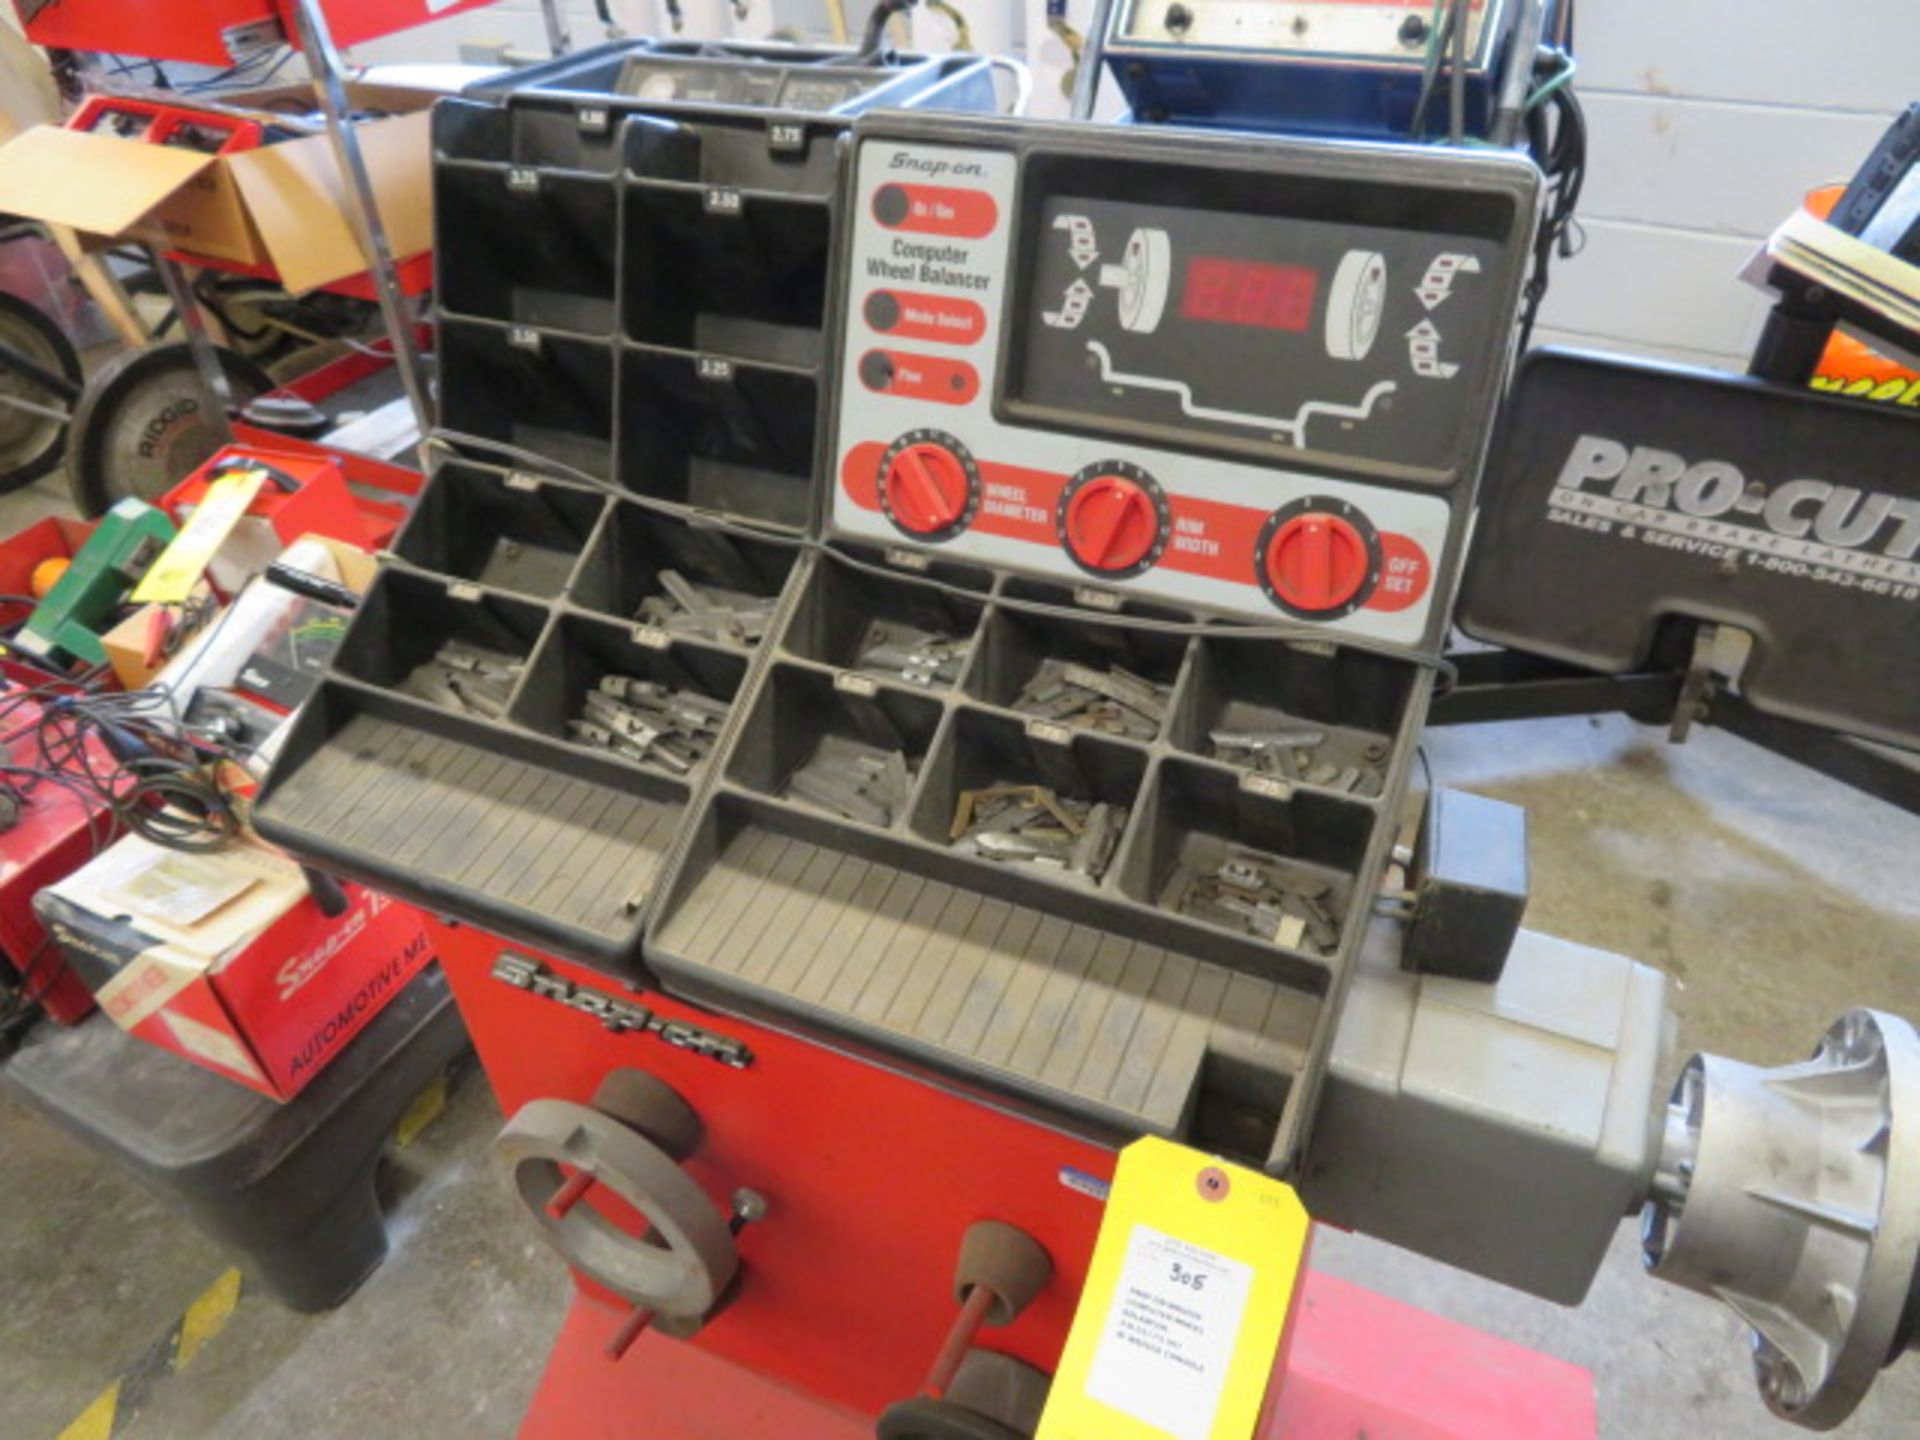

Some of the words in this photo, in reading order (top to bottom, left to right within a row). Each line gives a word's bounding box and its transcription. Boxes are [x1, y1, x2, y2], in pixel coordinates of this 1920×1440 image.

[773, 125, 801, 141] 2.75
[887, 152, 983, 178] Snap-on
[891, 238, 969, 264] Computer
[866, 257, 916, 280] Wheel
[919, 262, 990, 291] Balancer
[138, 398, 199, 459] RIDGID
[985, 482, 1027, 501] WHEEL
[1556, 434, 1920, 560] PRO-CUT
[983, 497, 1049, 524] DIAMETER
[1175, 516, 1205, 536] RIM
[1547, 509, 1612, 533] SALES
[1619, 524, 1637, 539] &
[1641, 530, 1741, 563] SERVICE
[1686, 520, 1779, 549] BRAKE
[1173, 534, 1220, 557] WIDTH
[1387, 556, 1420, 576] OFF
[1383, 573, 1415, 594] SET
[275, 907, 369, 1003] Snap-on
[289, 957, 403, 1081] AUTOMOTIVE
[490, 949, 756, 1071] Snap-on
[1169, 1261, 1208, 1291] 305
